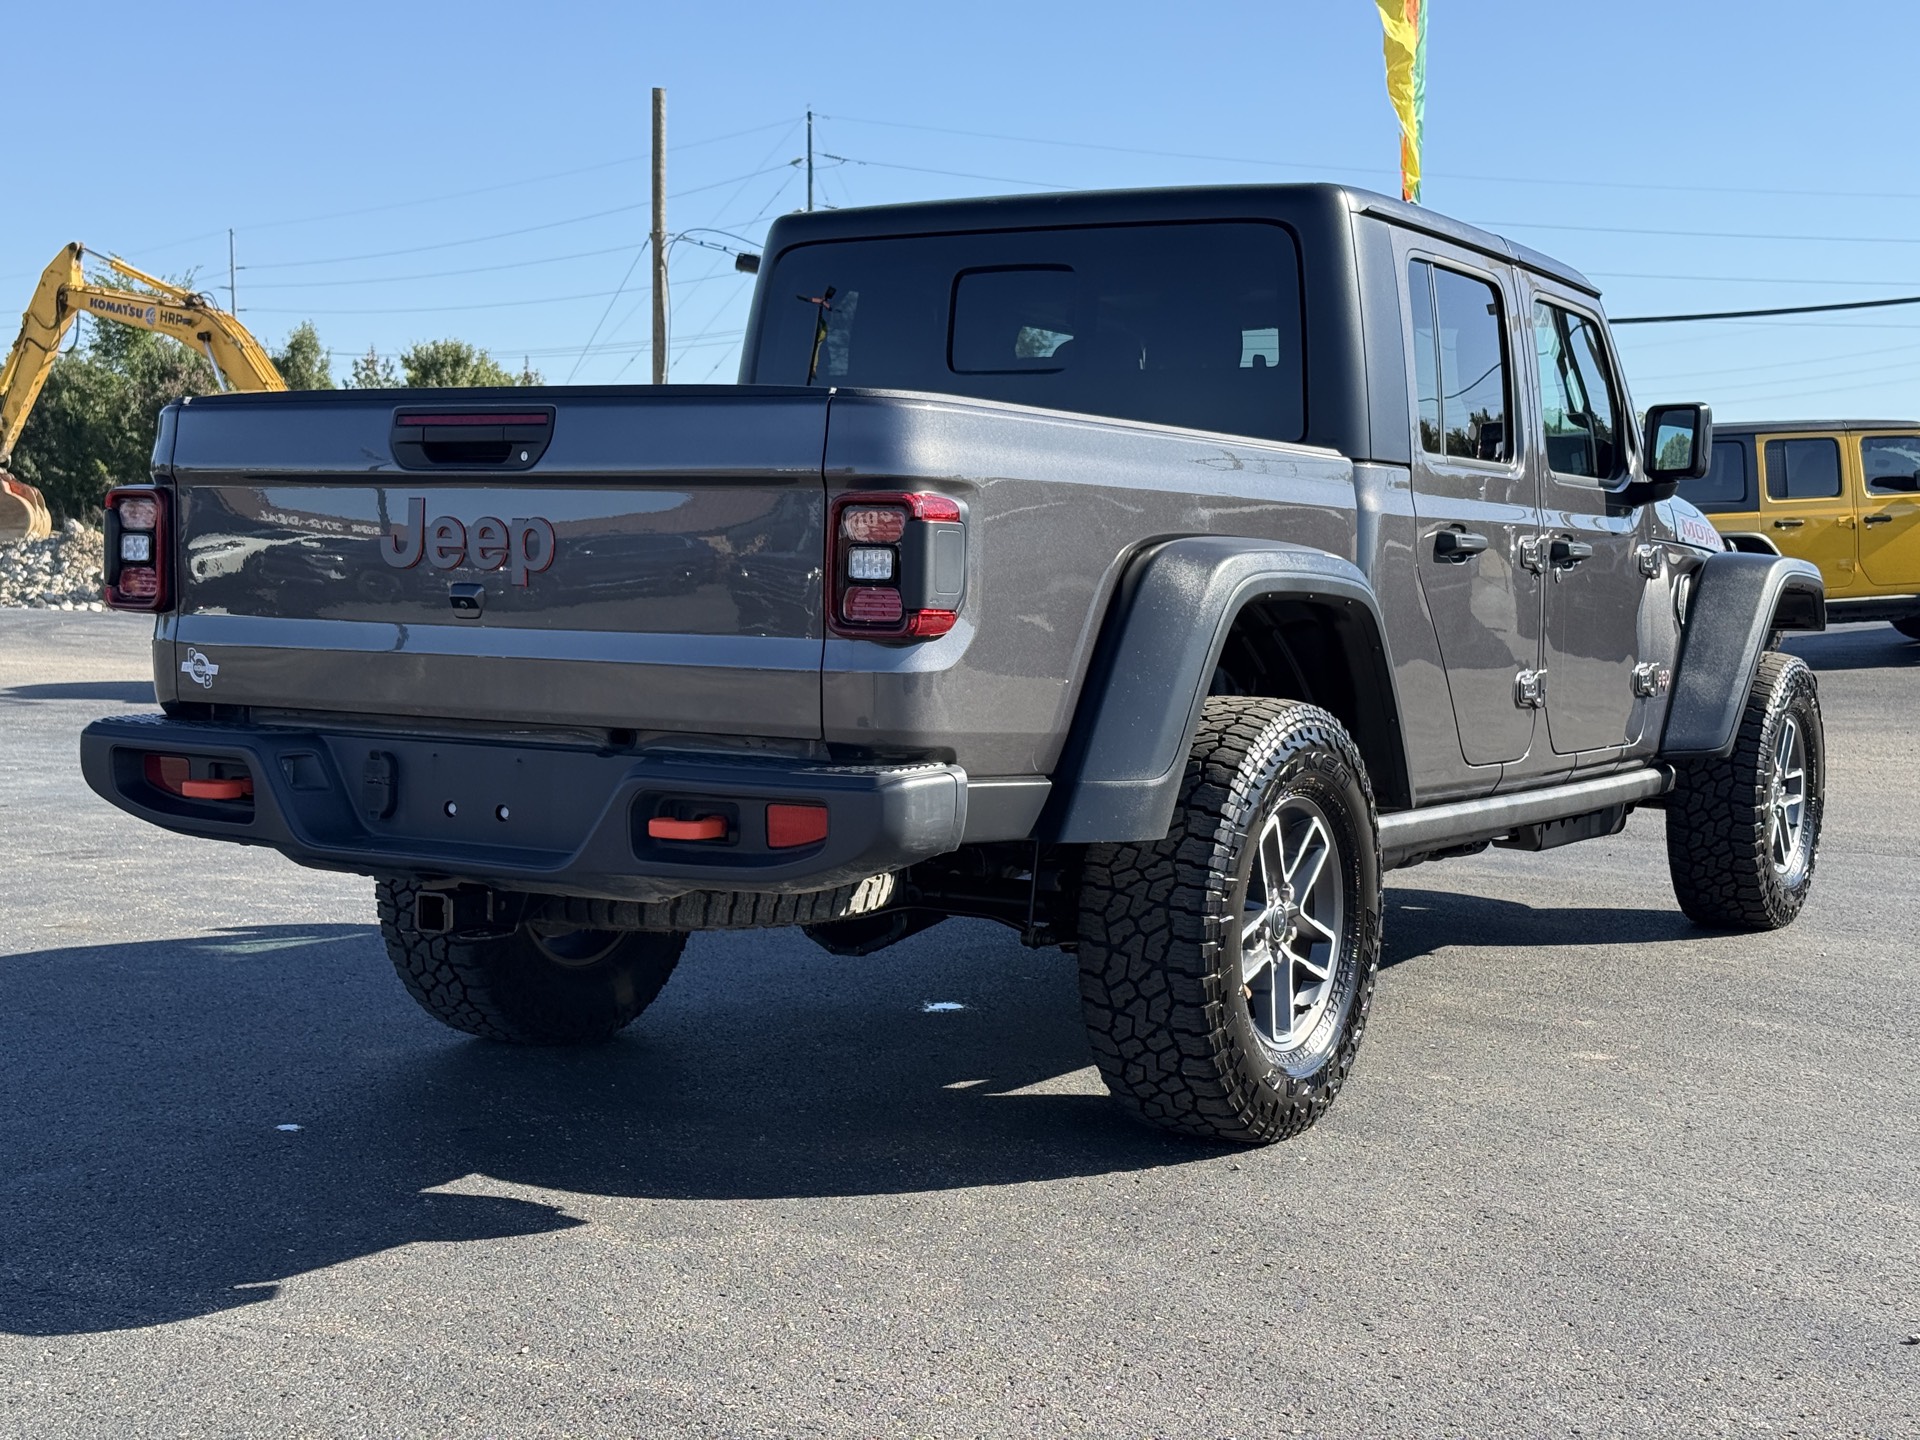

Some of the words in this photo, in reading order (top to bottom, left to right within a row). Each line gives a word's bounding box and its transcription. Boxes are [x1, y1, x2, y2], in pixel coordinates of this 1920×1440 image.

[90, 298, 143, 319] KOMATSU
[160, 310, 183, 325] HRP
[380, 497, 556, 588] Jeep
